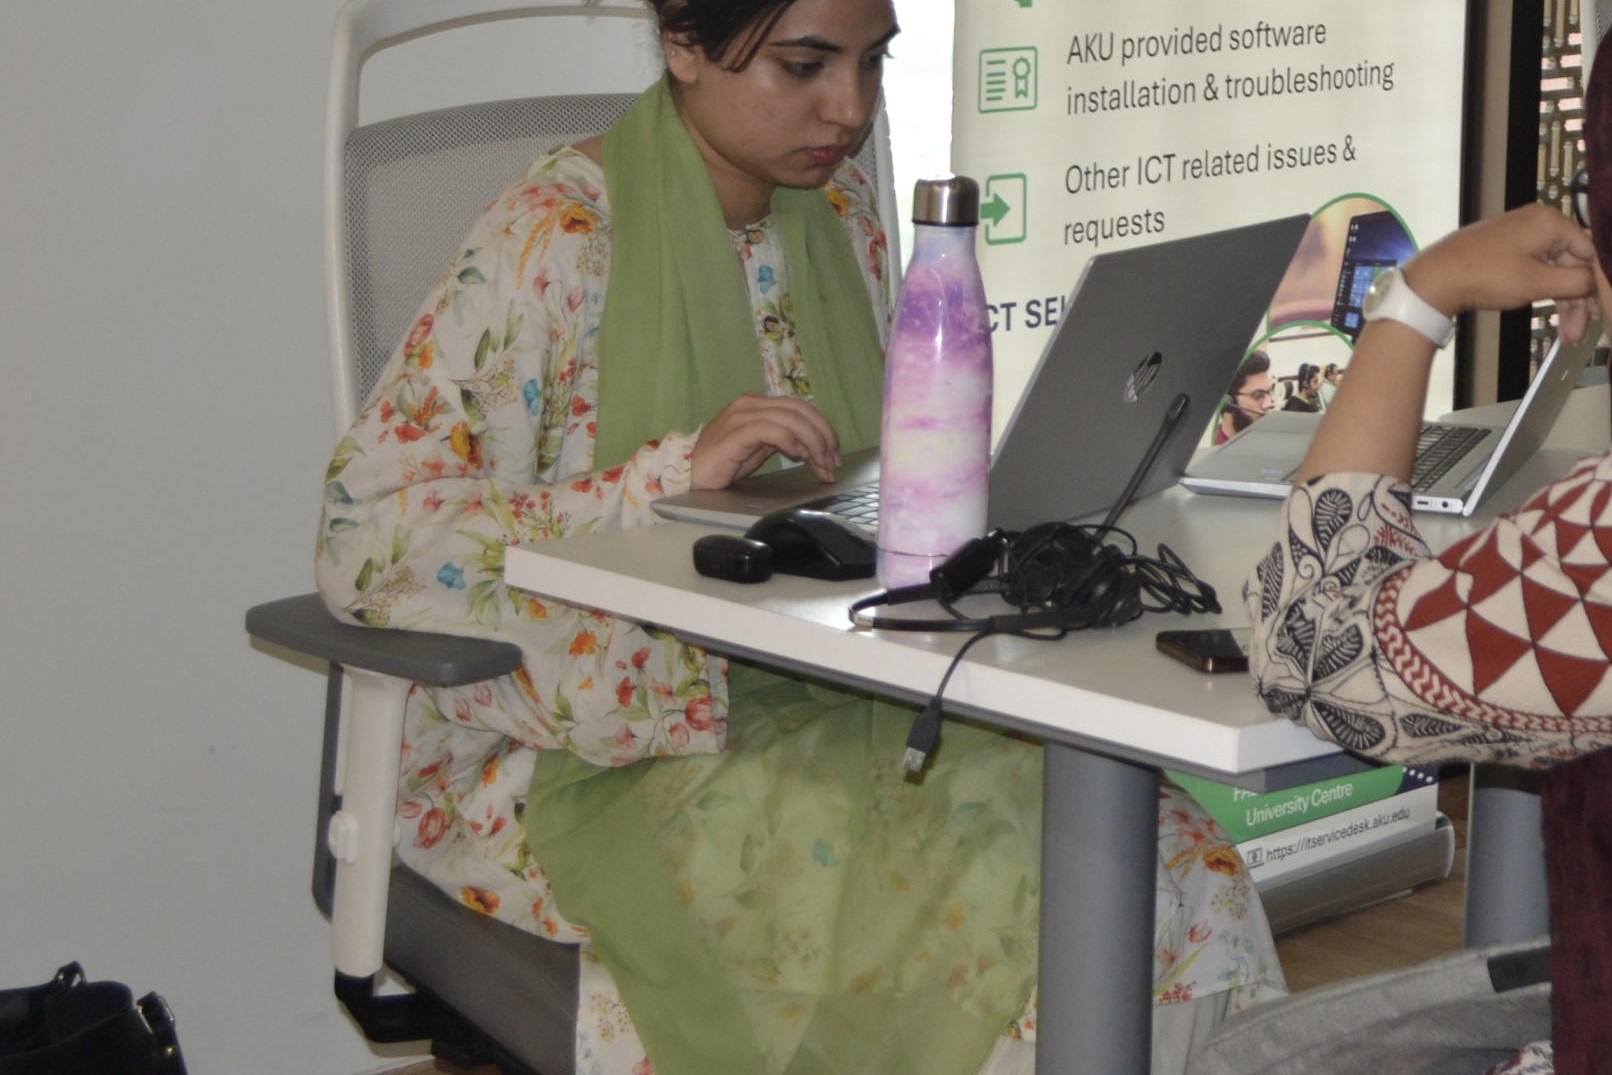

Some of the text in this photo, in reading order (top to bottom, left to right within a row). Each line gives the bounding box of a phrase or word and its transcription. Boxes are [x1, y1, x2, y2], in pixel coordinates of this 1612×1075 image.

[1067, 20, 1327, 65] AKU provided software
[1067, 60, 1395, 115] installation & troubleshooting
[1065, 134, 1356, 194] Other ICT related issues &
[1064, 208, 1165, 246] requests
[986, 295, 1066, 333] CT SE
[1246, 783, 1353, 826] University Centre
